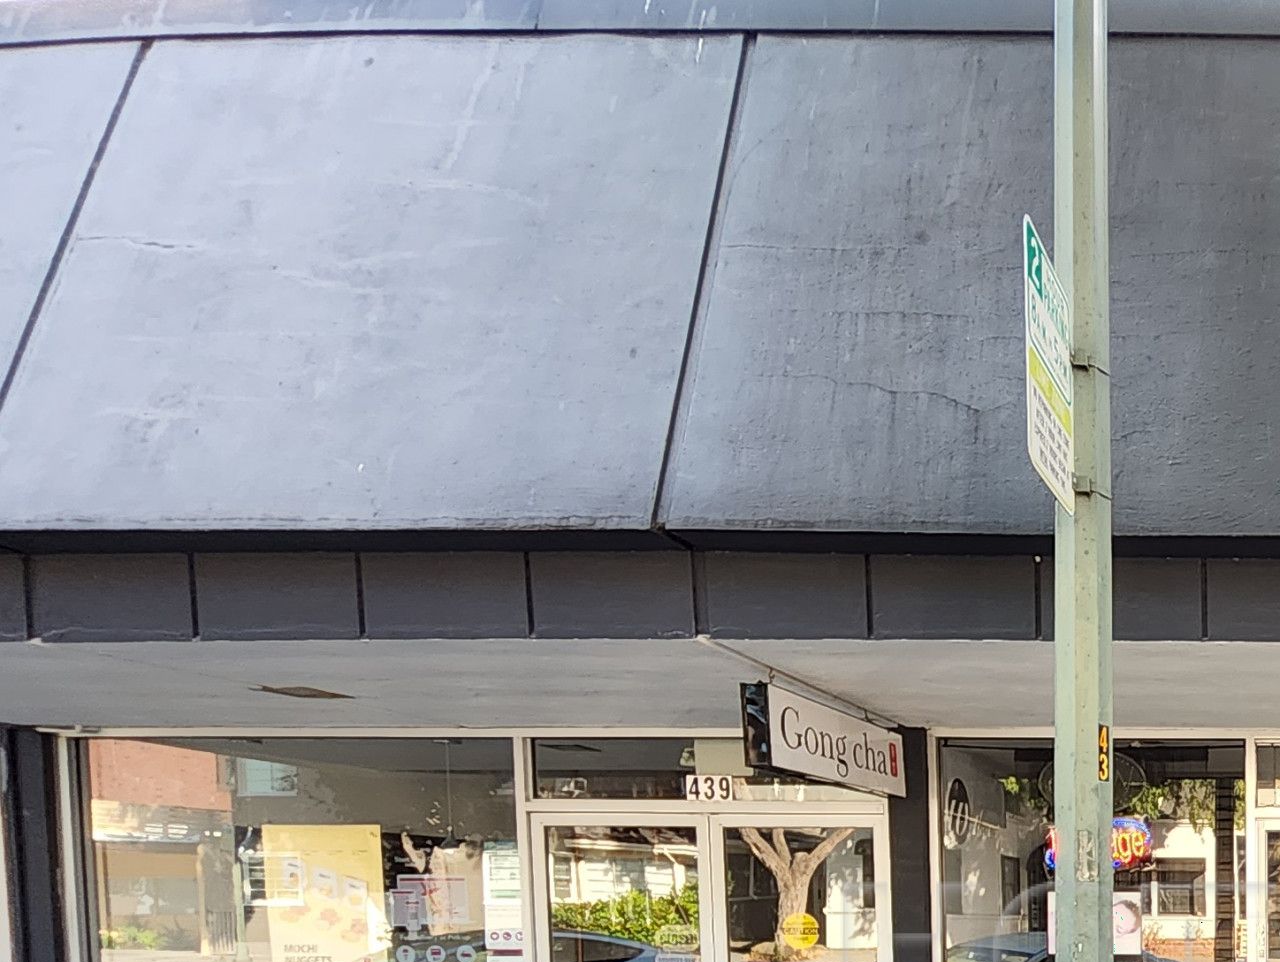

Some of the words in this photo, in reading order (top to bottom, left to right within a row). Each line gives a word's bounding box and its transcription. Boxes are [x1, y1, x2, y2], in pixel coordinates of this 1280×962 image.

[1031, 236, 1040, 290] 2
[781, 706, 849, 778] Gong
[853, 732, 888, 776] cha
[689, 777, 730, 800] 439
[284, 944, 318, 953] MOCHI
